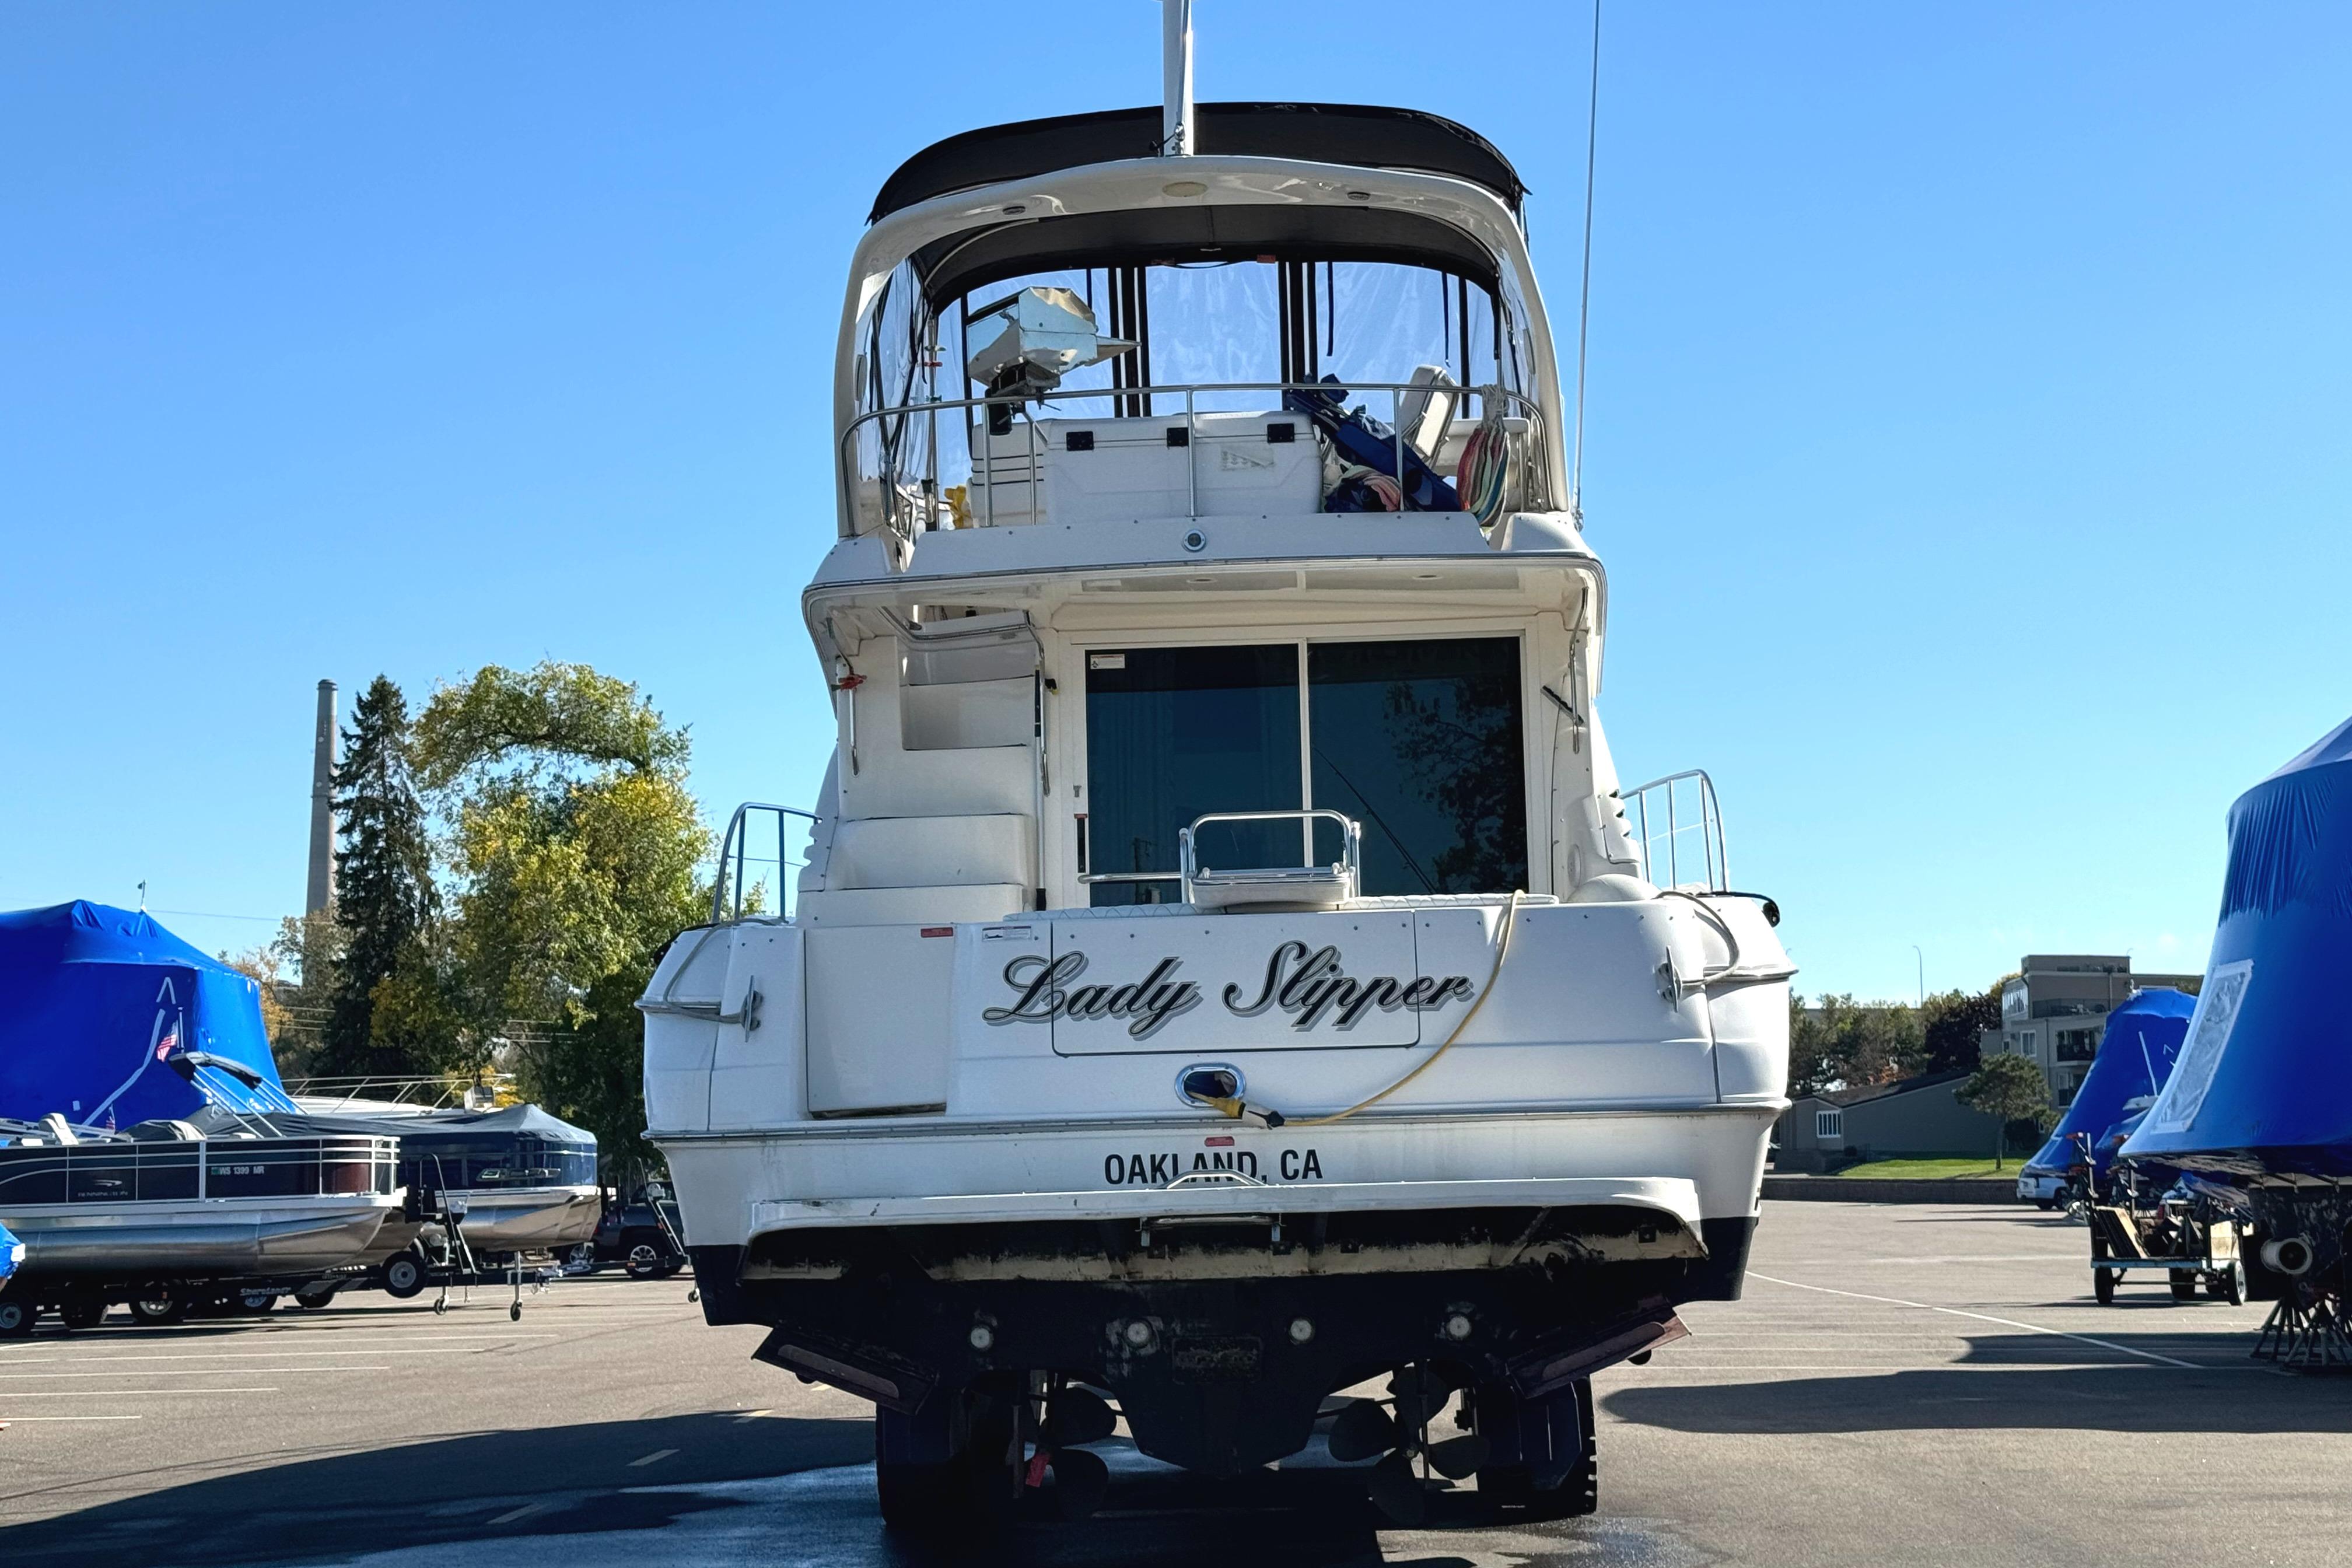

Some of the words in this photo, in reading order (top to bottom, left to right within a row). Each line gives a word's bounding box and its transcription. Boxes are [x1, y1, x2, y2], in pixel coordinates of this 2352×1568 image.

[982, 950, 1203, 1041] Lady
[1221, 940, 1475, 1032] Slipper
[220, 1167, 232, 1175] WS
[1104, 1151, 1268, 1184] OAKLAND,
[1280, 1149, 1323, 1180] CA
